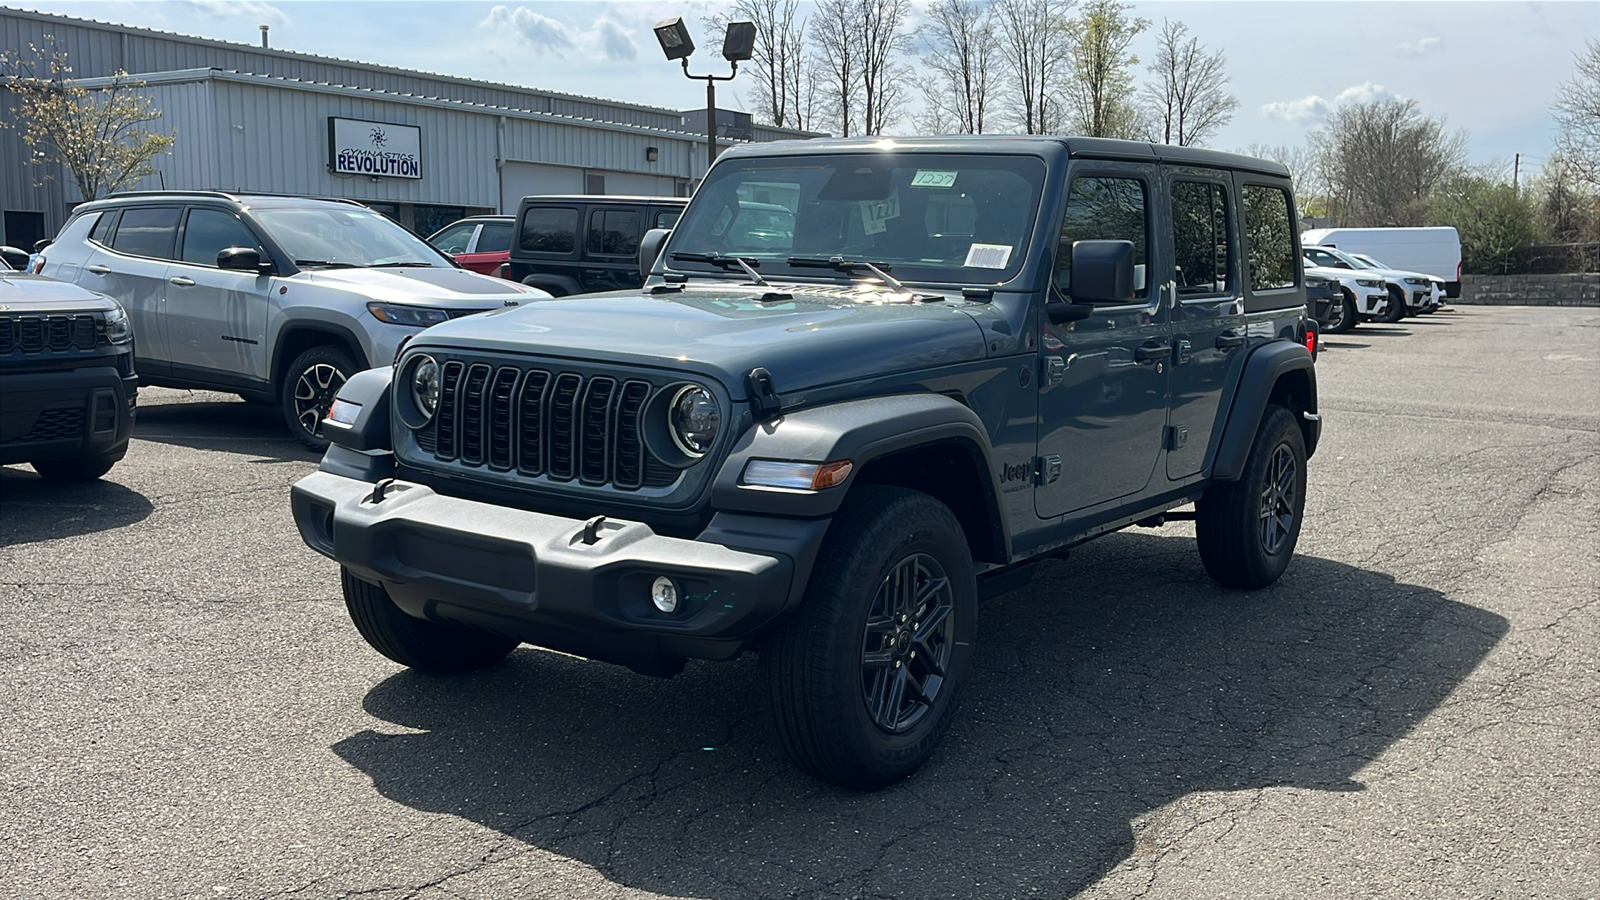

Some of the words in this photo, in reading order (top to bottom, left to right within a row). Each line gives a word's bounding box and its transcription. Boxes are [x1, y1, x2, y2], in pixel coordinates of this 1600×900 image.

[341, 148, 414, 161] GYMNASTICS
[338, 154, 418, 176] REVOLUTION
[916, 172, 955, 185] 1227
[999, 462, 1030, 483] Jeep
